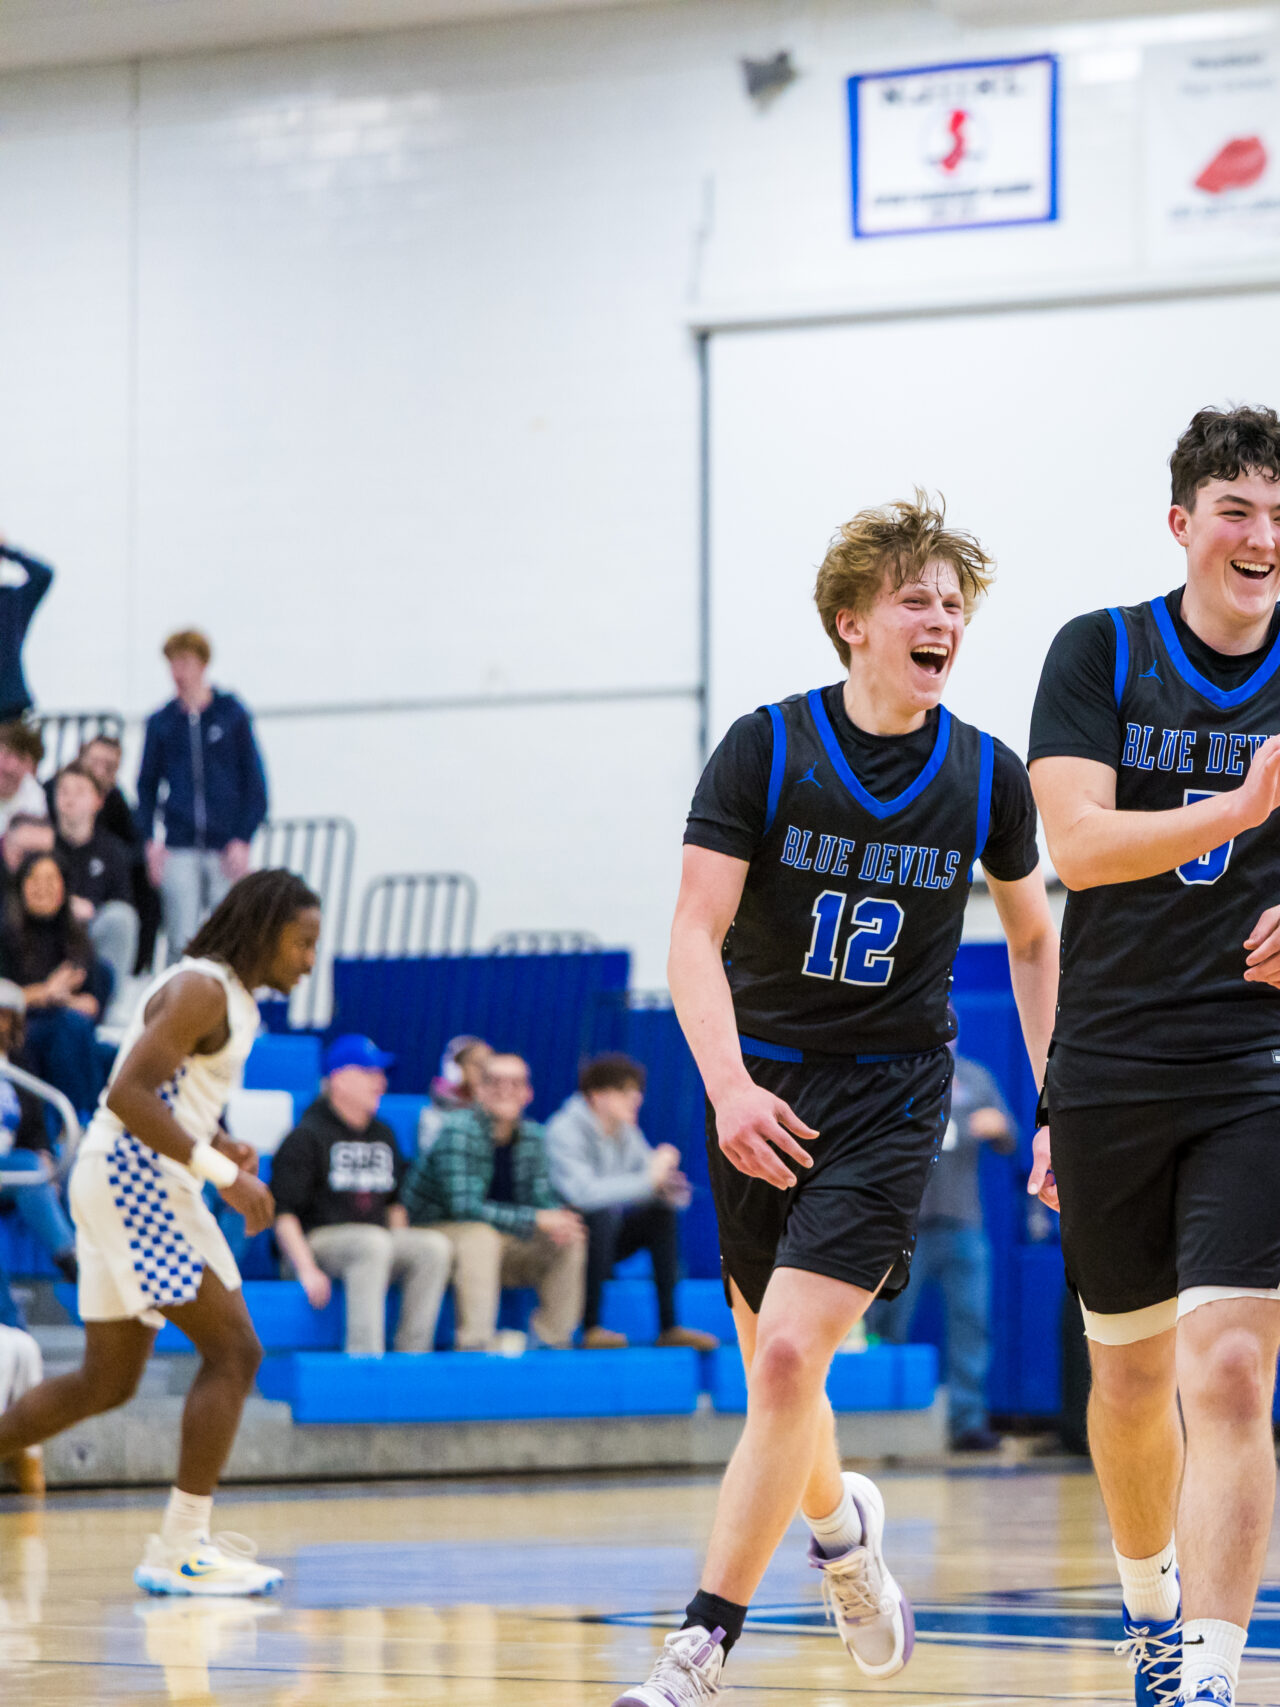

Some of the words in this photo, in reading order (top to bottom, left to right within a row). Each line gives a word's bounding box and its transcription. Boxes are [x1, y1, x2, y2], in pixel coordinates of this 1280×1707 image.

[1121, 722, 1197, 774] BLUE
[780, 824, 855, 877] BLUE
[858, 842, 961, 890] DEVILS
[801, 889, 905, 987] 12
